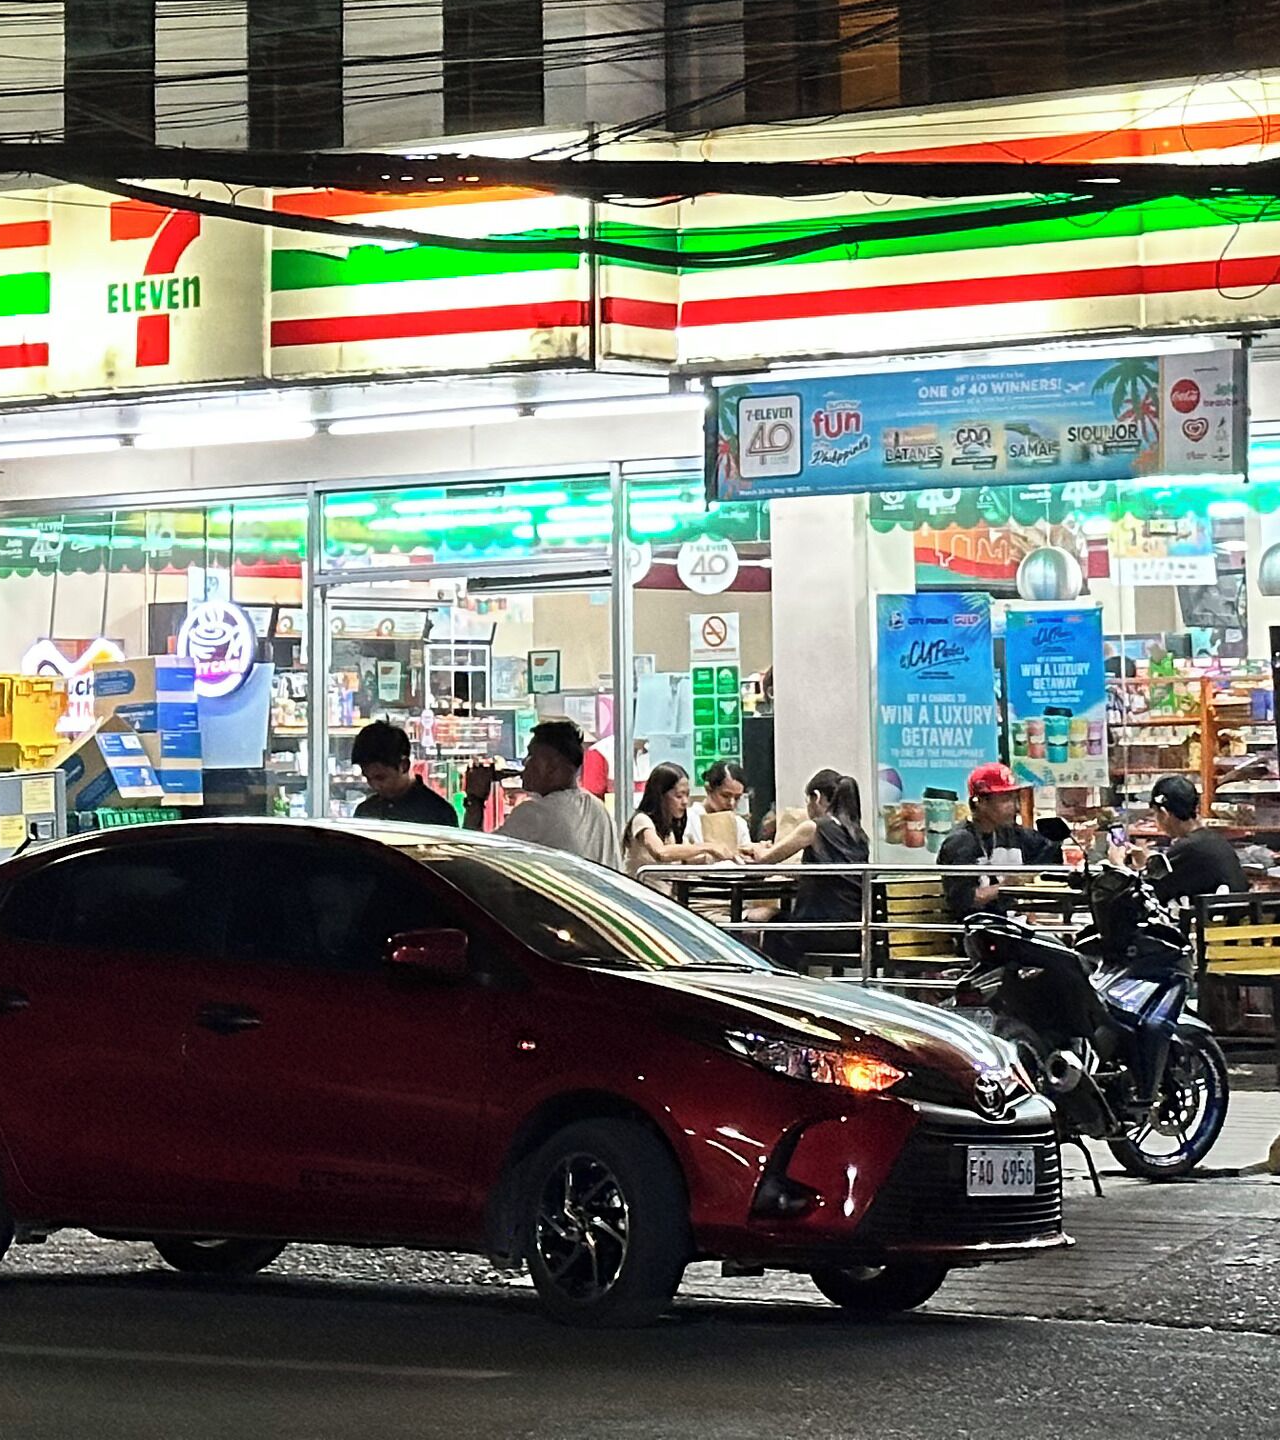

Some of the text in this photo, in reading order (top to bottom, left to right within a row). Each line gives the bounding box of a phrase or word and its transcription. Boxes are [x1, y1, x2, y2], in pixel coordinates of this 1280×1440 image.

[107, 274, 202, 313] ELEVEN
[918, 377, 1062, 399] ONE of 40 WINNERS!
[745, 407, 793, 422] 7-ELEVEN
[885, 445, 944, 462] BATANES
[1020, 662, 1090, 677] WIN A LUXURY
[1032, 677, 1079, 690] GETAWAY
[881, 704, 994, 725] WIN A LUXURY
[901, 727, 974, 747] GETAWAY
